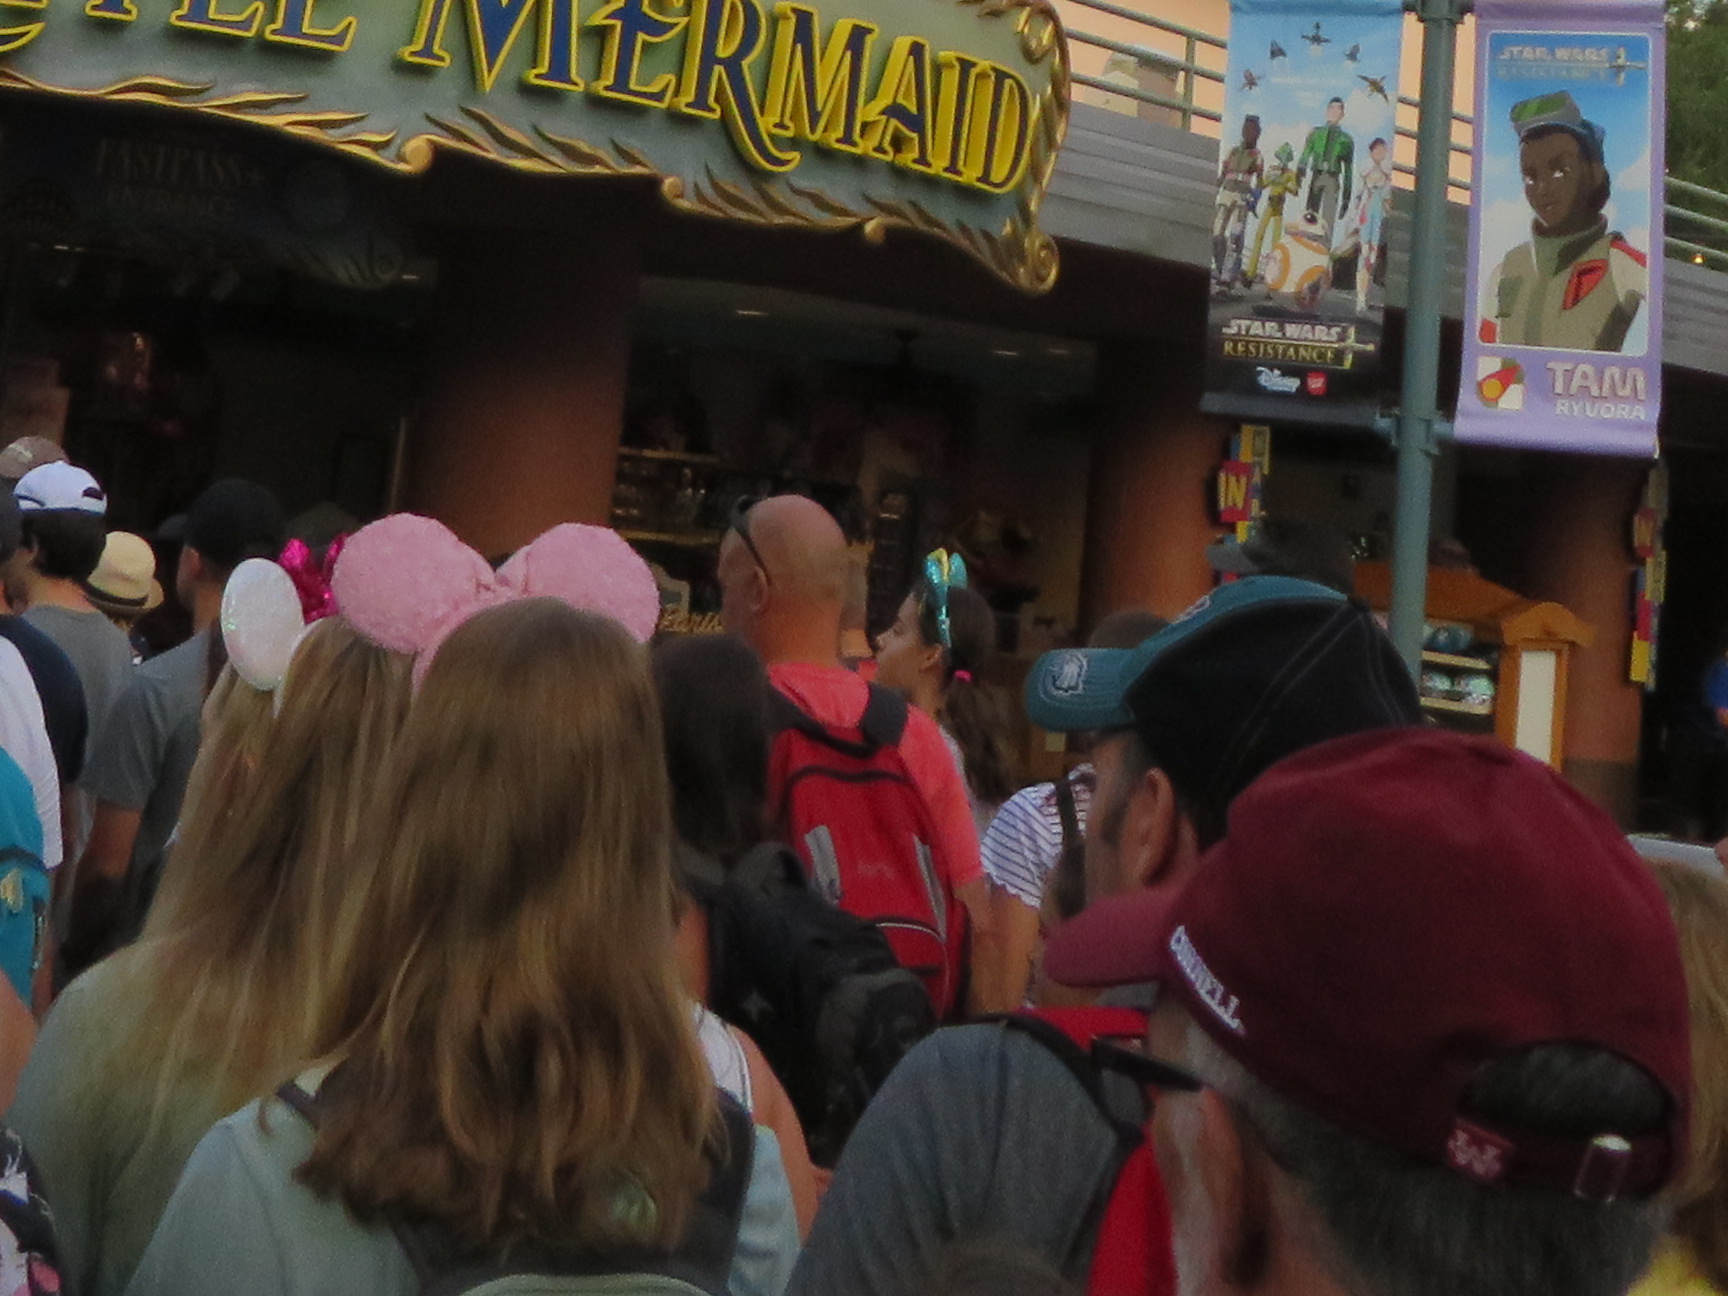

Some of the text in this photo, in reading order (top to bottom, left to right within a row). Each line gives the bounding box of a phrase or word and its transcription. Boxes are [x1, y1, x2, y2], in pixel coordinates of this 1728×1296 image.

[1499, 46, 1610, 62] STAR WARS
[1222, 318, 1342, 342] STAR WARS
[1223, 340, 1335, 364] RESISTANCE
[1545, 360, 1646, 401] TAM
